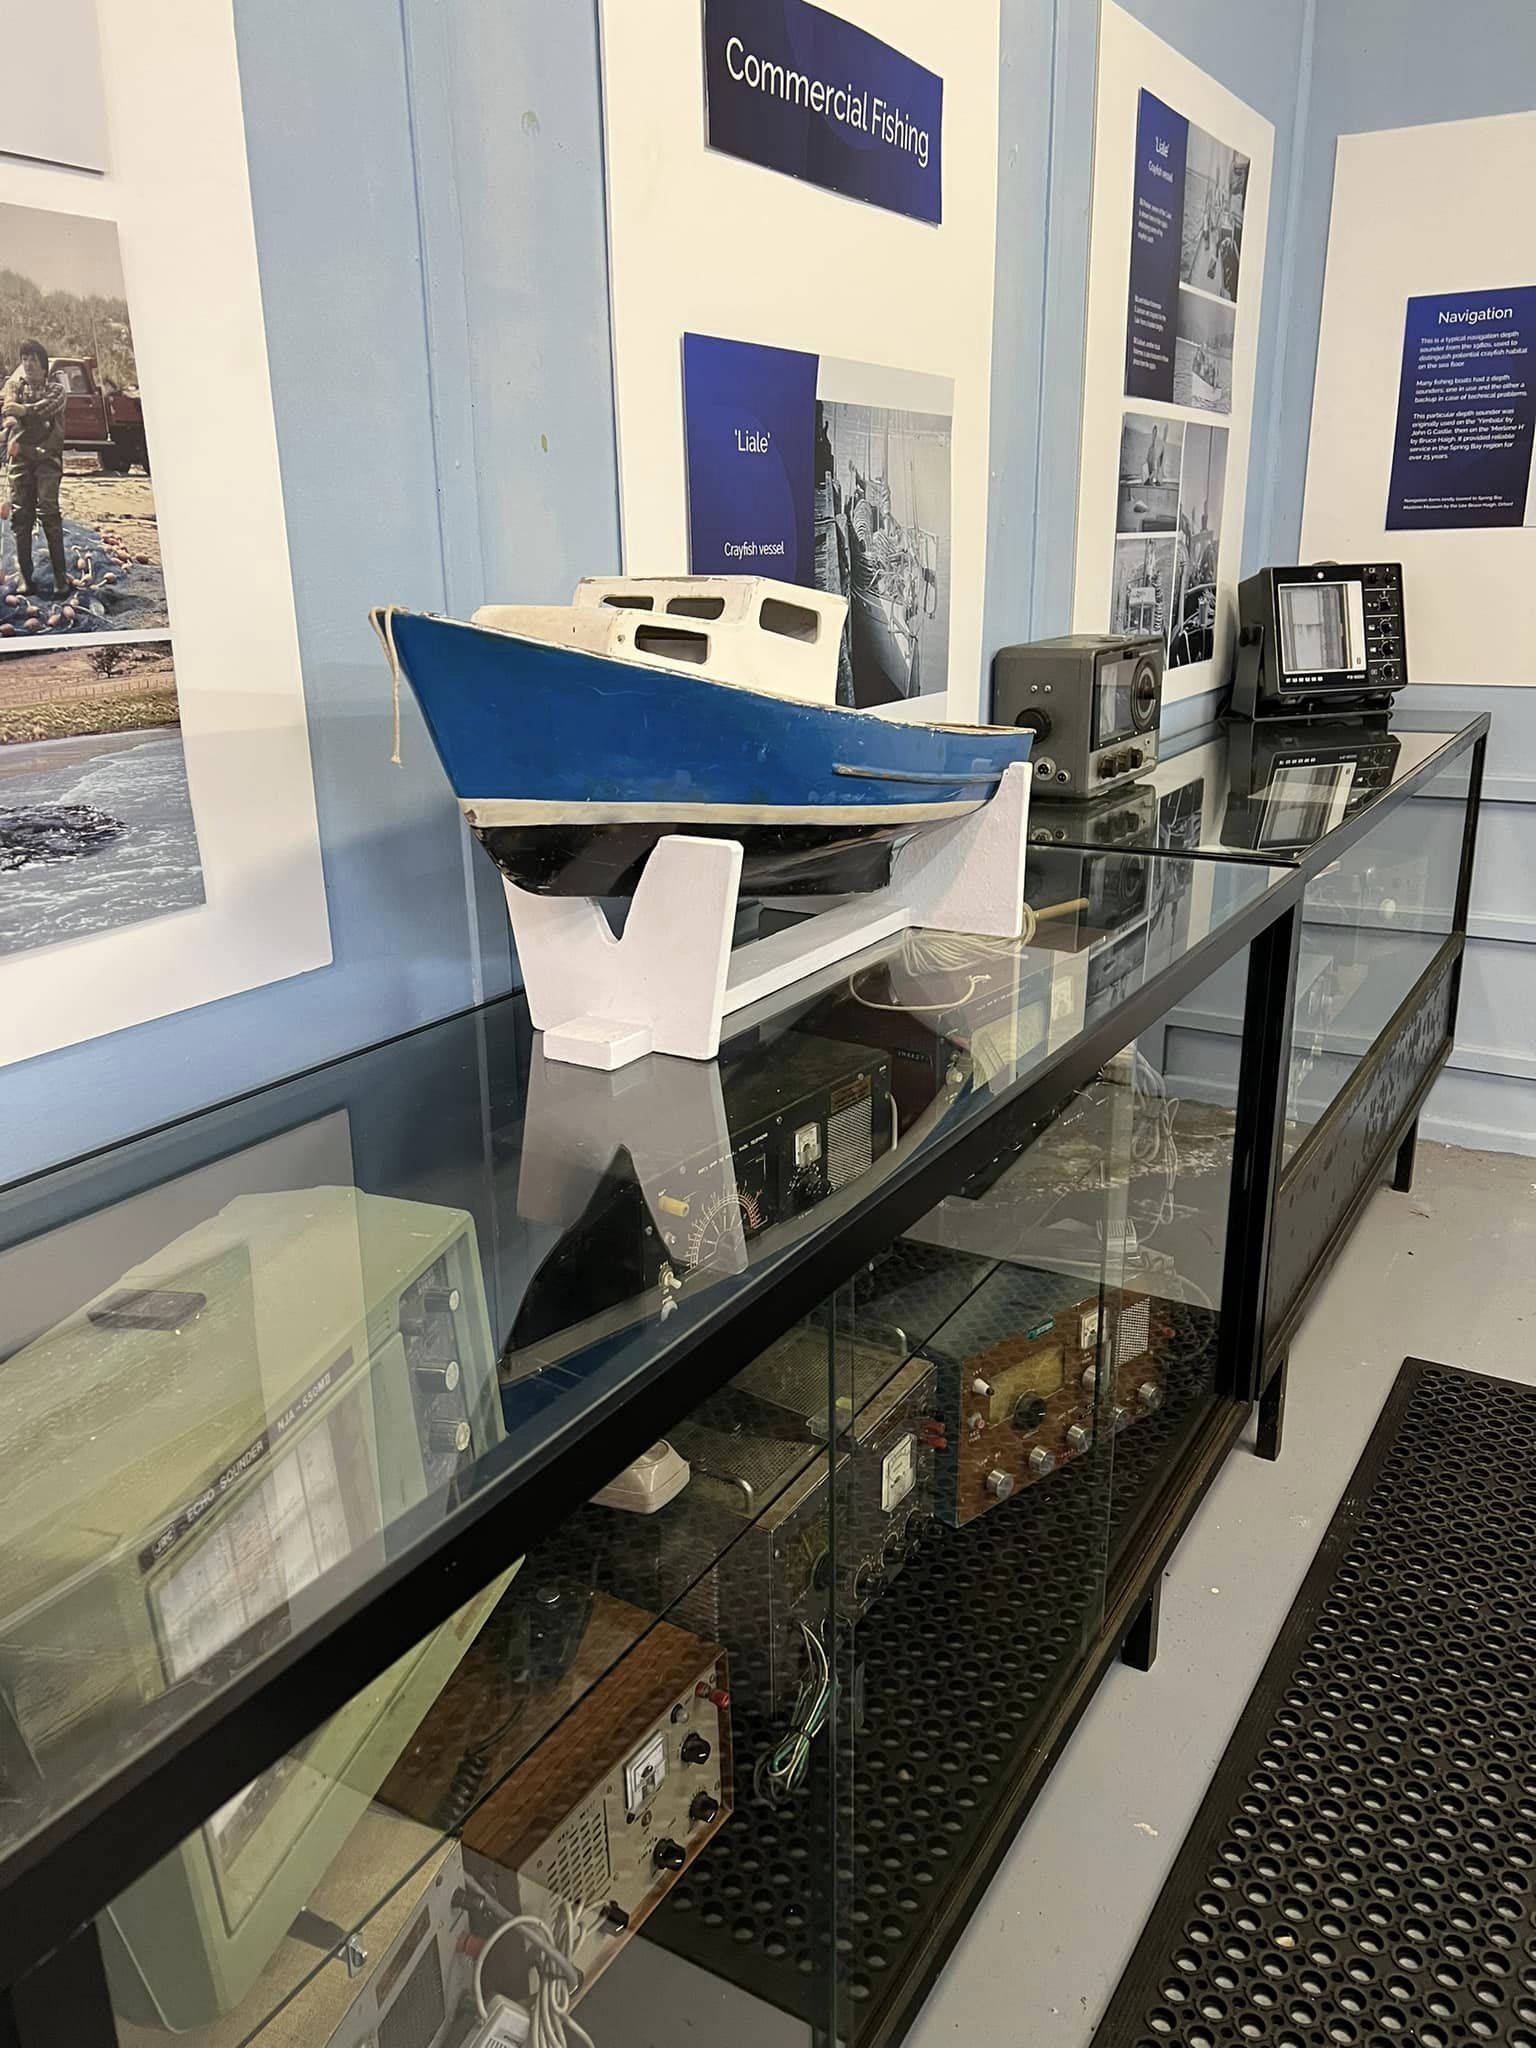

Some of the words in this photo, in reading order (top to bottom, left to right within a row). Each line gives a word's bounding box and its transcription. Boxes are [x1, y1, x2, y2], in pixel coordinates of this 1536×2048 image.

[726, 37, 867, 131] Commercial
[872, 98, 929, 168] Fishing
[1438, 307, 1513, 324] Navigation
[734, 429, 771, 454] 'Liale'
[724, 542, 759, 558] Crayfish
[759, 541, 785, 556] vessel
[186, 1489, 215, 1522] ECHO
[219, 1441, 264, 1490] SOUNDER
